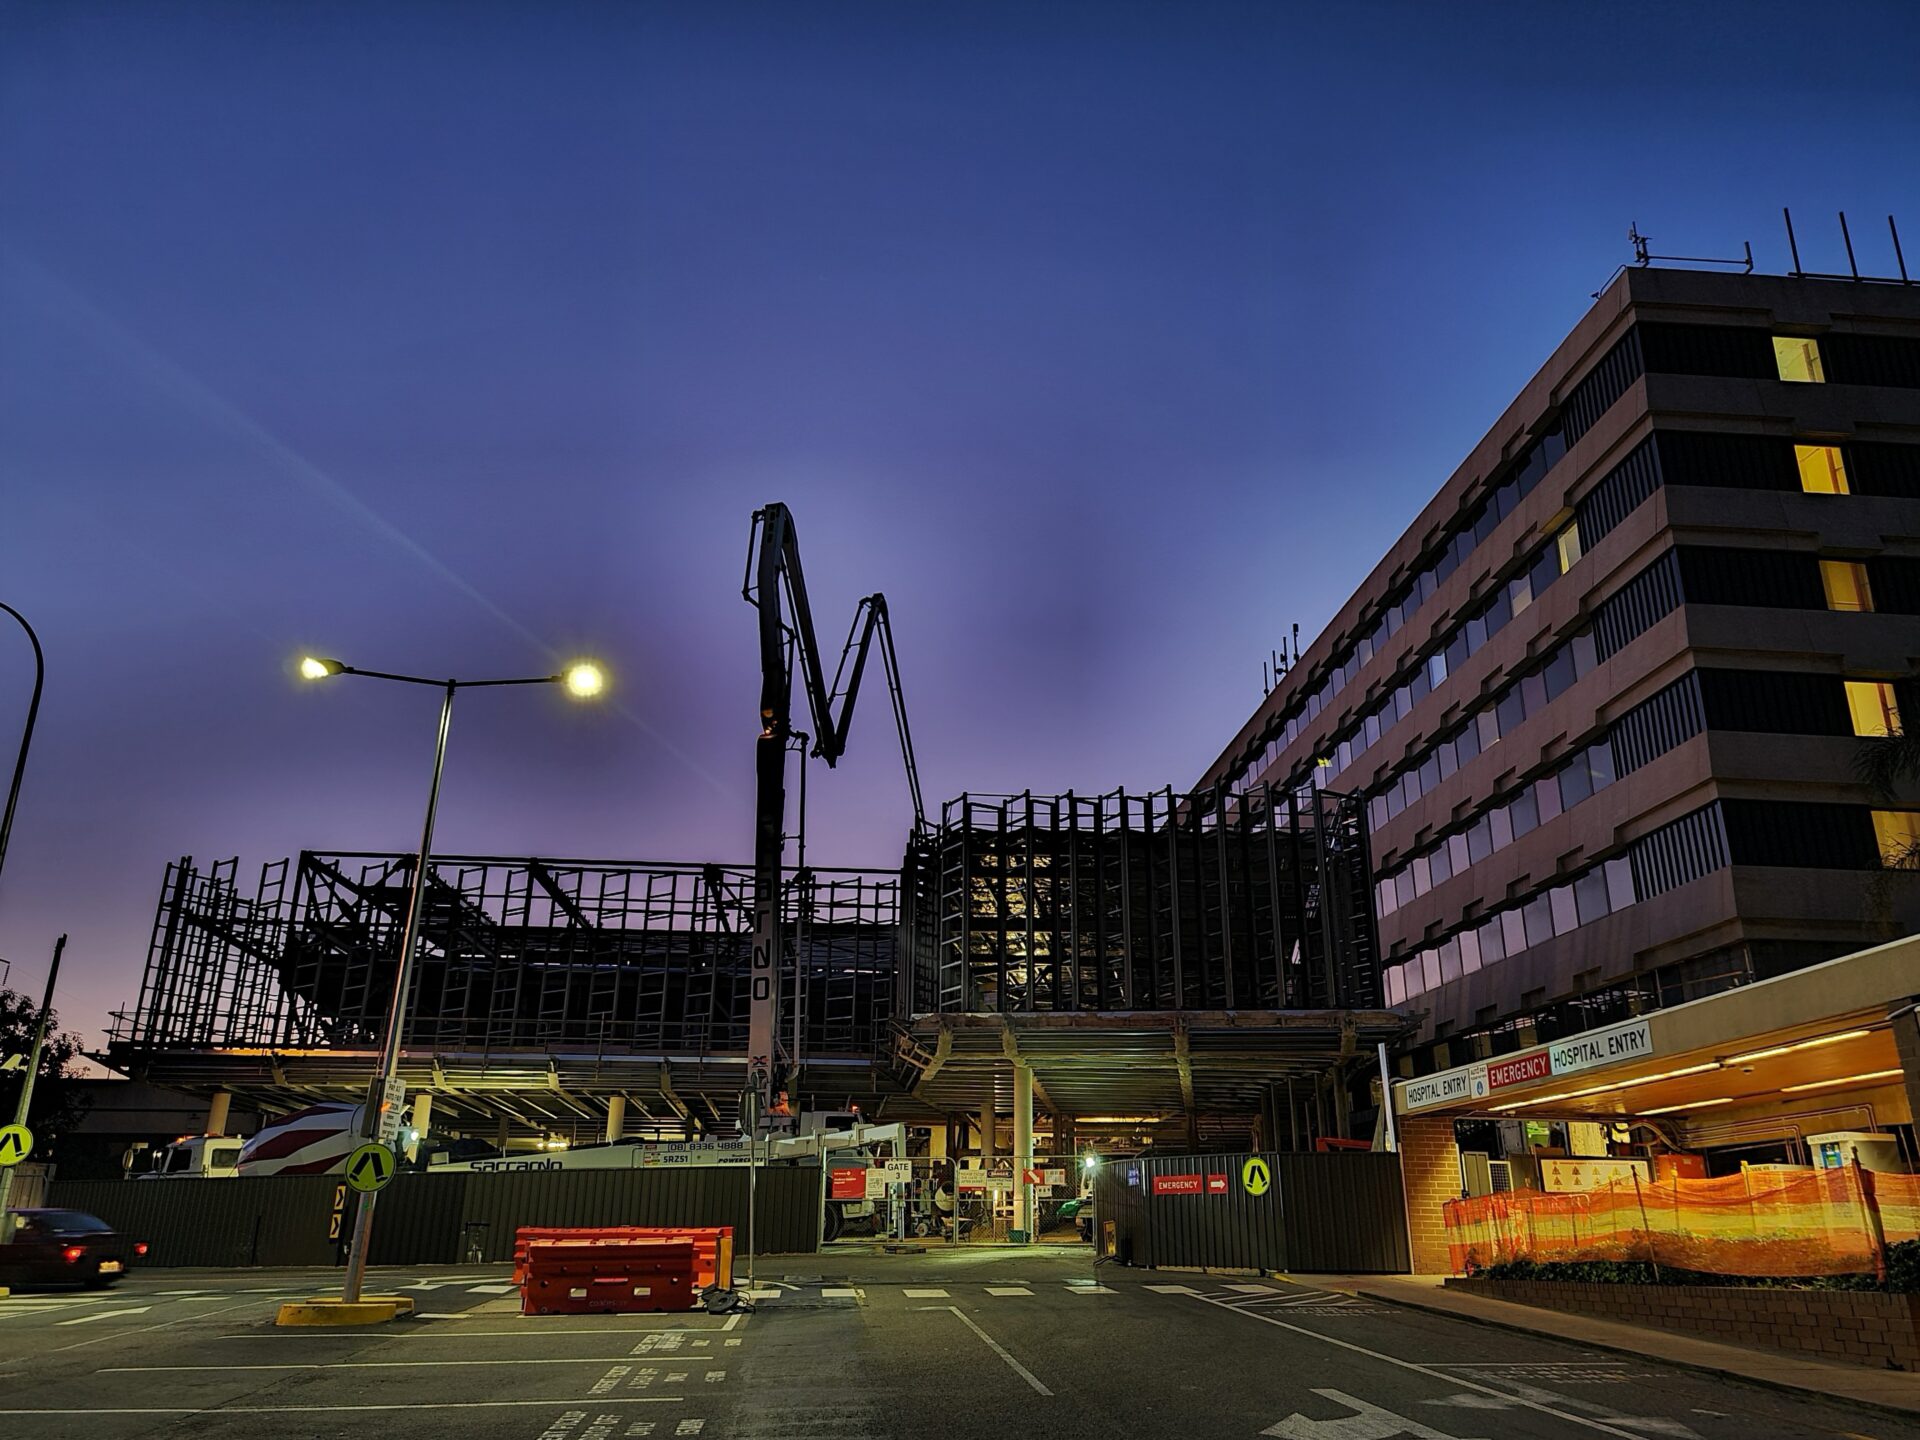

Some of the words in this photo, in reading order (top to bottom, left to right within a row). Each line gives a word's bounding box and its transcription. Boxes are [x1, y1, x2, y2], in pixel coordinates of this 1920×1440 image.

[1553, 1041, 1604, 1069] HOSPITAL
[1608, 1028, 1646, 1055] ENTRY
[1490, 1056, 1548, 1087] EMERGENCY
[1408, 1083, 1440, 1103] HOSPITAL
[1443, 1075, 1467, 1095] ENTRY
[668, 1143, 686, 1152] (08)
[689, 1142, 714, 1151] 8336
[717, 1141, 744, 1150] 4888
[887, 1163, 909, 1171] GATE
[895, 1172, 901, 1180] 3
[1158, 1181, 1199, 1190] EMERGENCY
